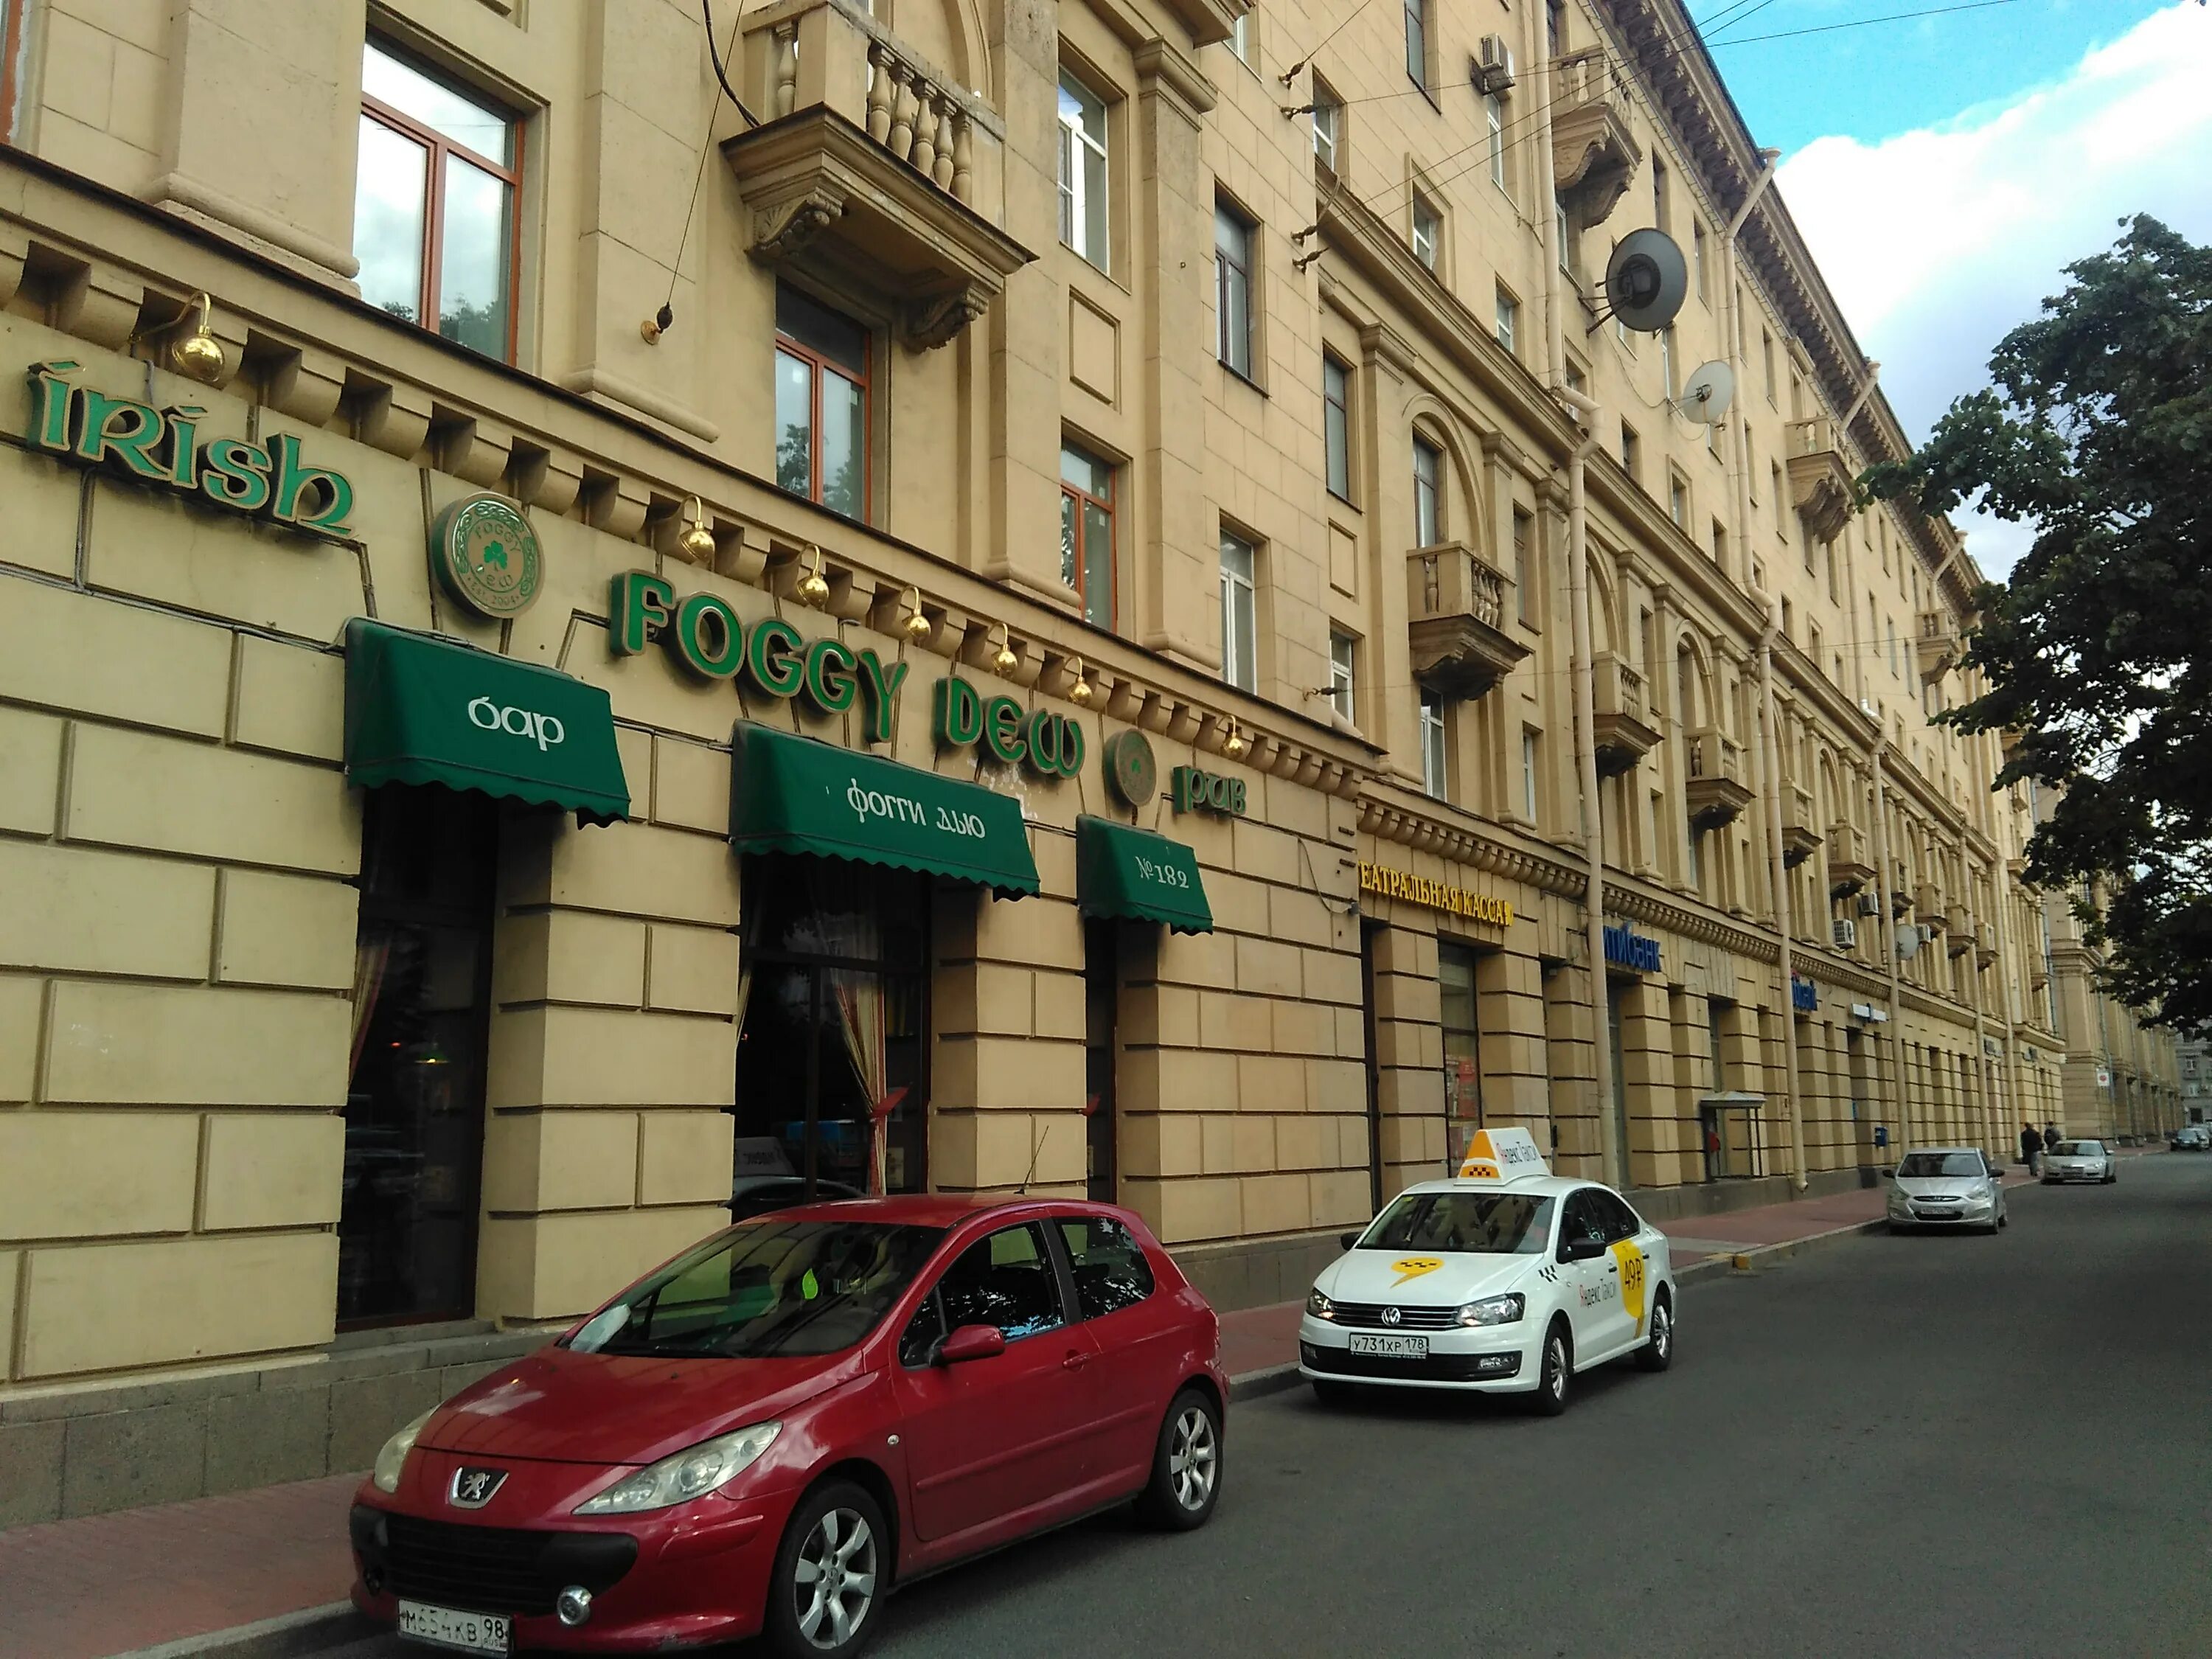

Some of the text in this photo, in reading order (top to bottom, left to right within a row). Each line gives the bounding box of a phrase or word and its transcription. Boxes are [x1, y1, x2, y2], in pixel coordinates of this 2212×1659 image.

[611, 568, 910, 743] FOGGY
[468, 696, 565, 751] бар
[847, 778, 986, 838] фогги дью
[1358, 860, 1459, 913] ЕАТРАЛЬНАЯ
[484, 1618, 504, 1639] 98
